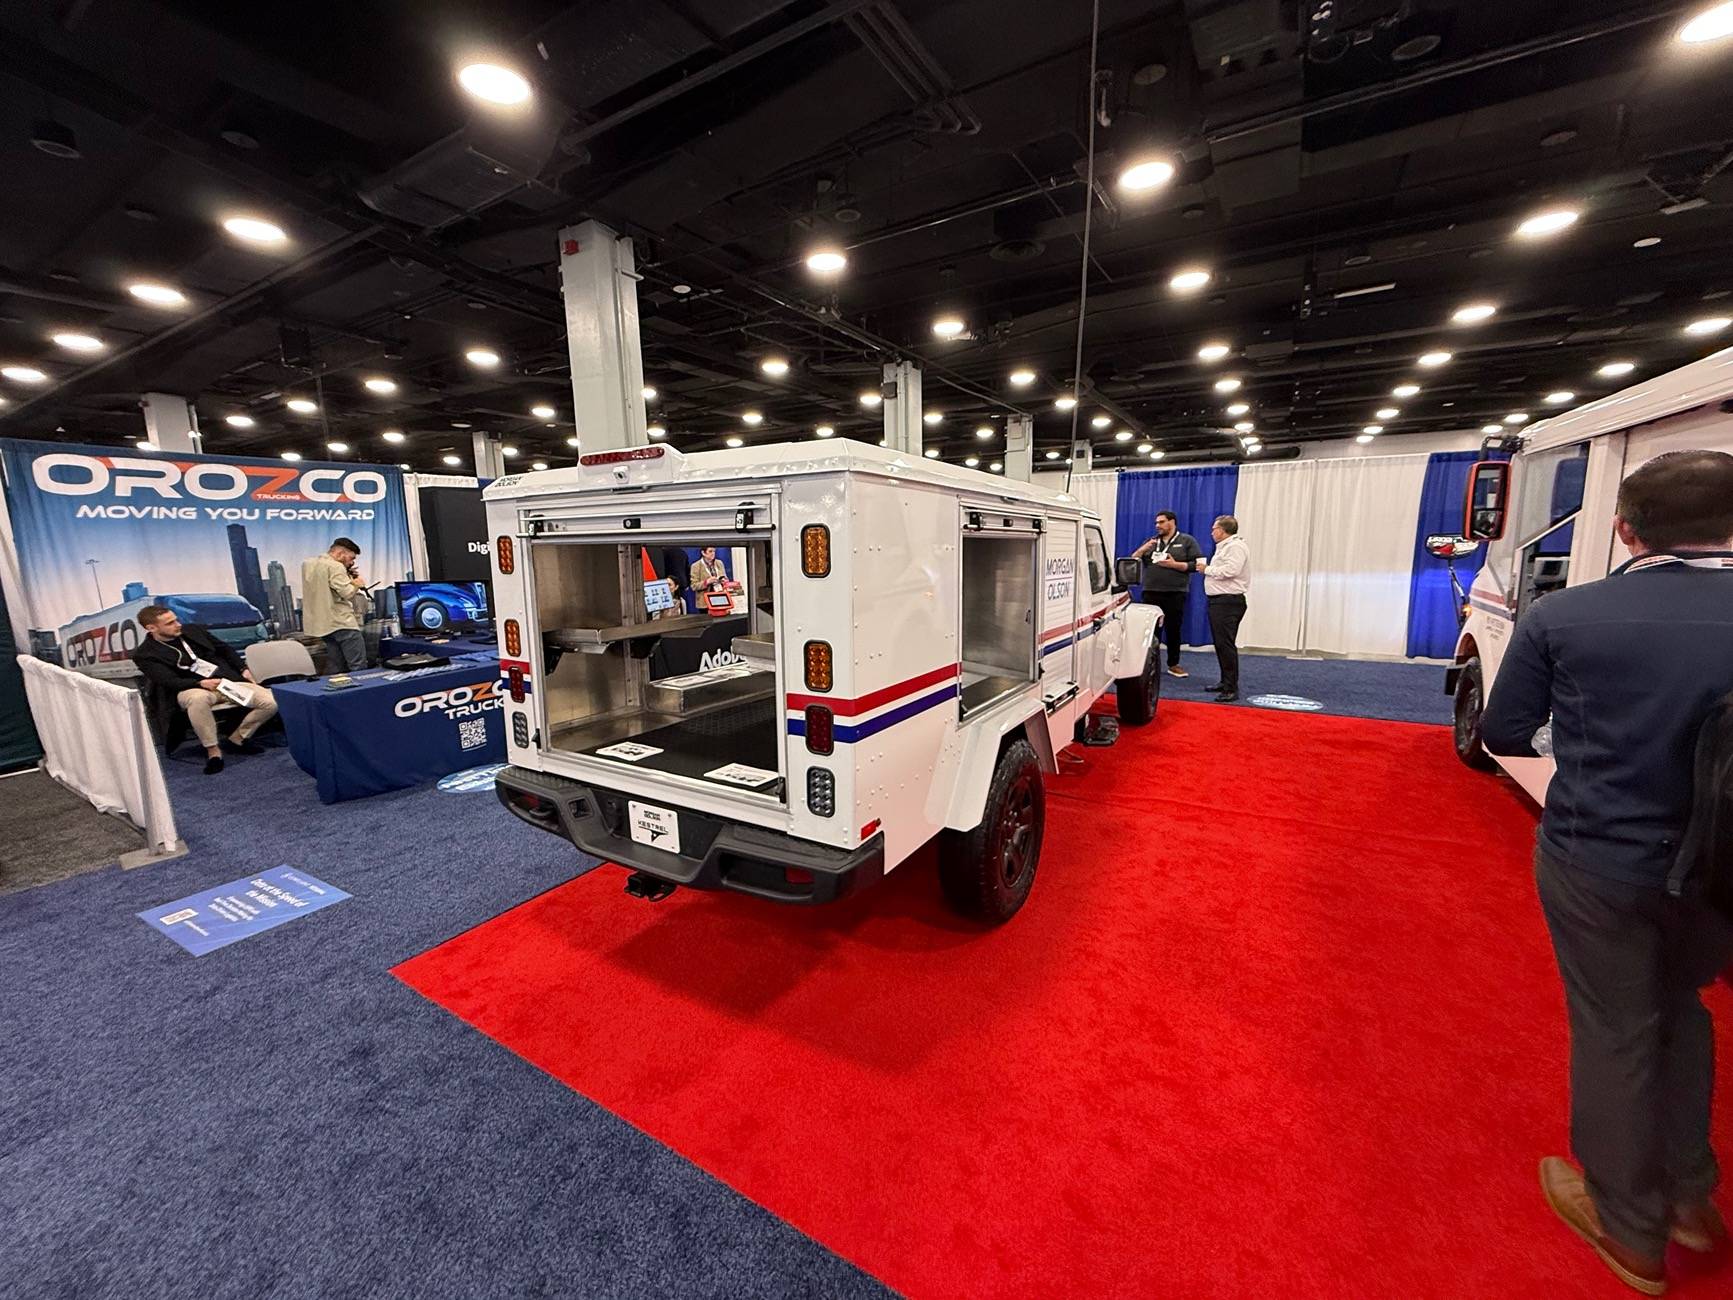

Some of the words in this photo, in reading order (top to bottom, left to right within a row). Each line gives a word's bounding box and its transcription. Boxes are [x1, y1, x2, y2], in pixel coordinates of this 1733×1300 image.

[32, 453, 387, 504] OROZCO
[256, 493, 300, 501] TRUCKING
[76, 504, 198, 520] MOVING
[204, 507, 260, 520] YOU
[265, 508, 375, 521] FORWARD
[1046, 558, 1074, 576] MORGAN
[1047, 581, 1070, 600] OLSON
[67, 618, 139, 668] OROZCO
